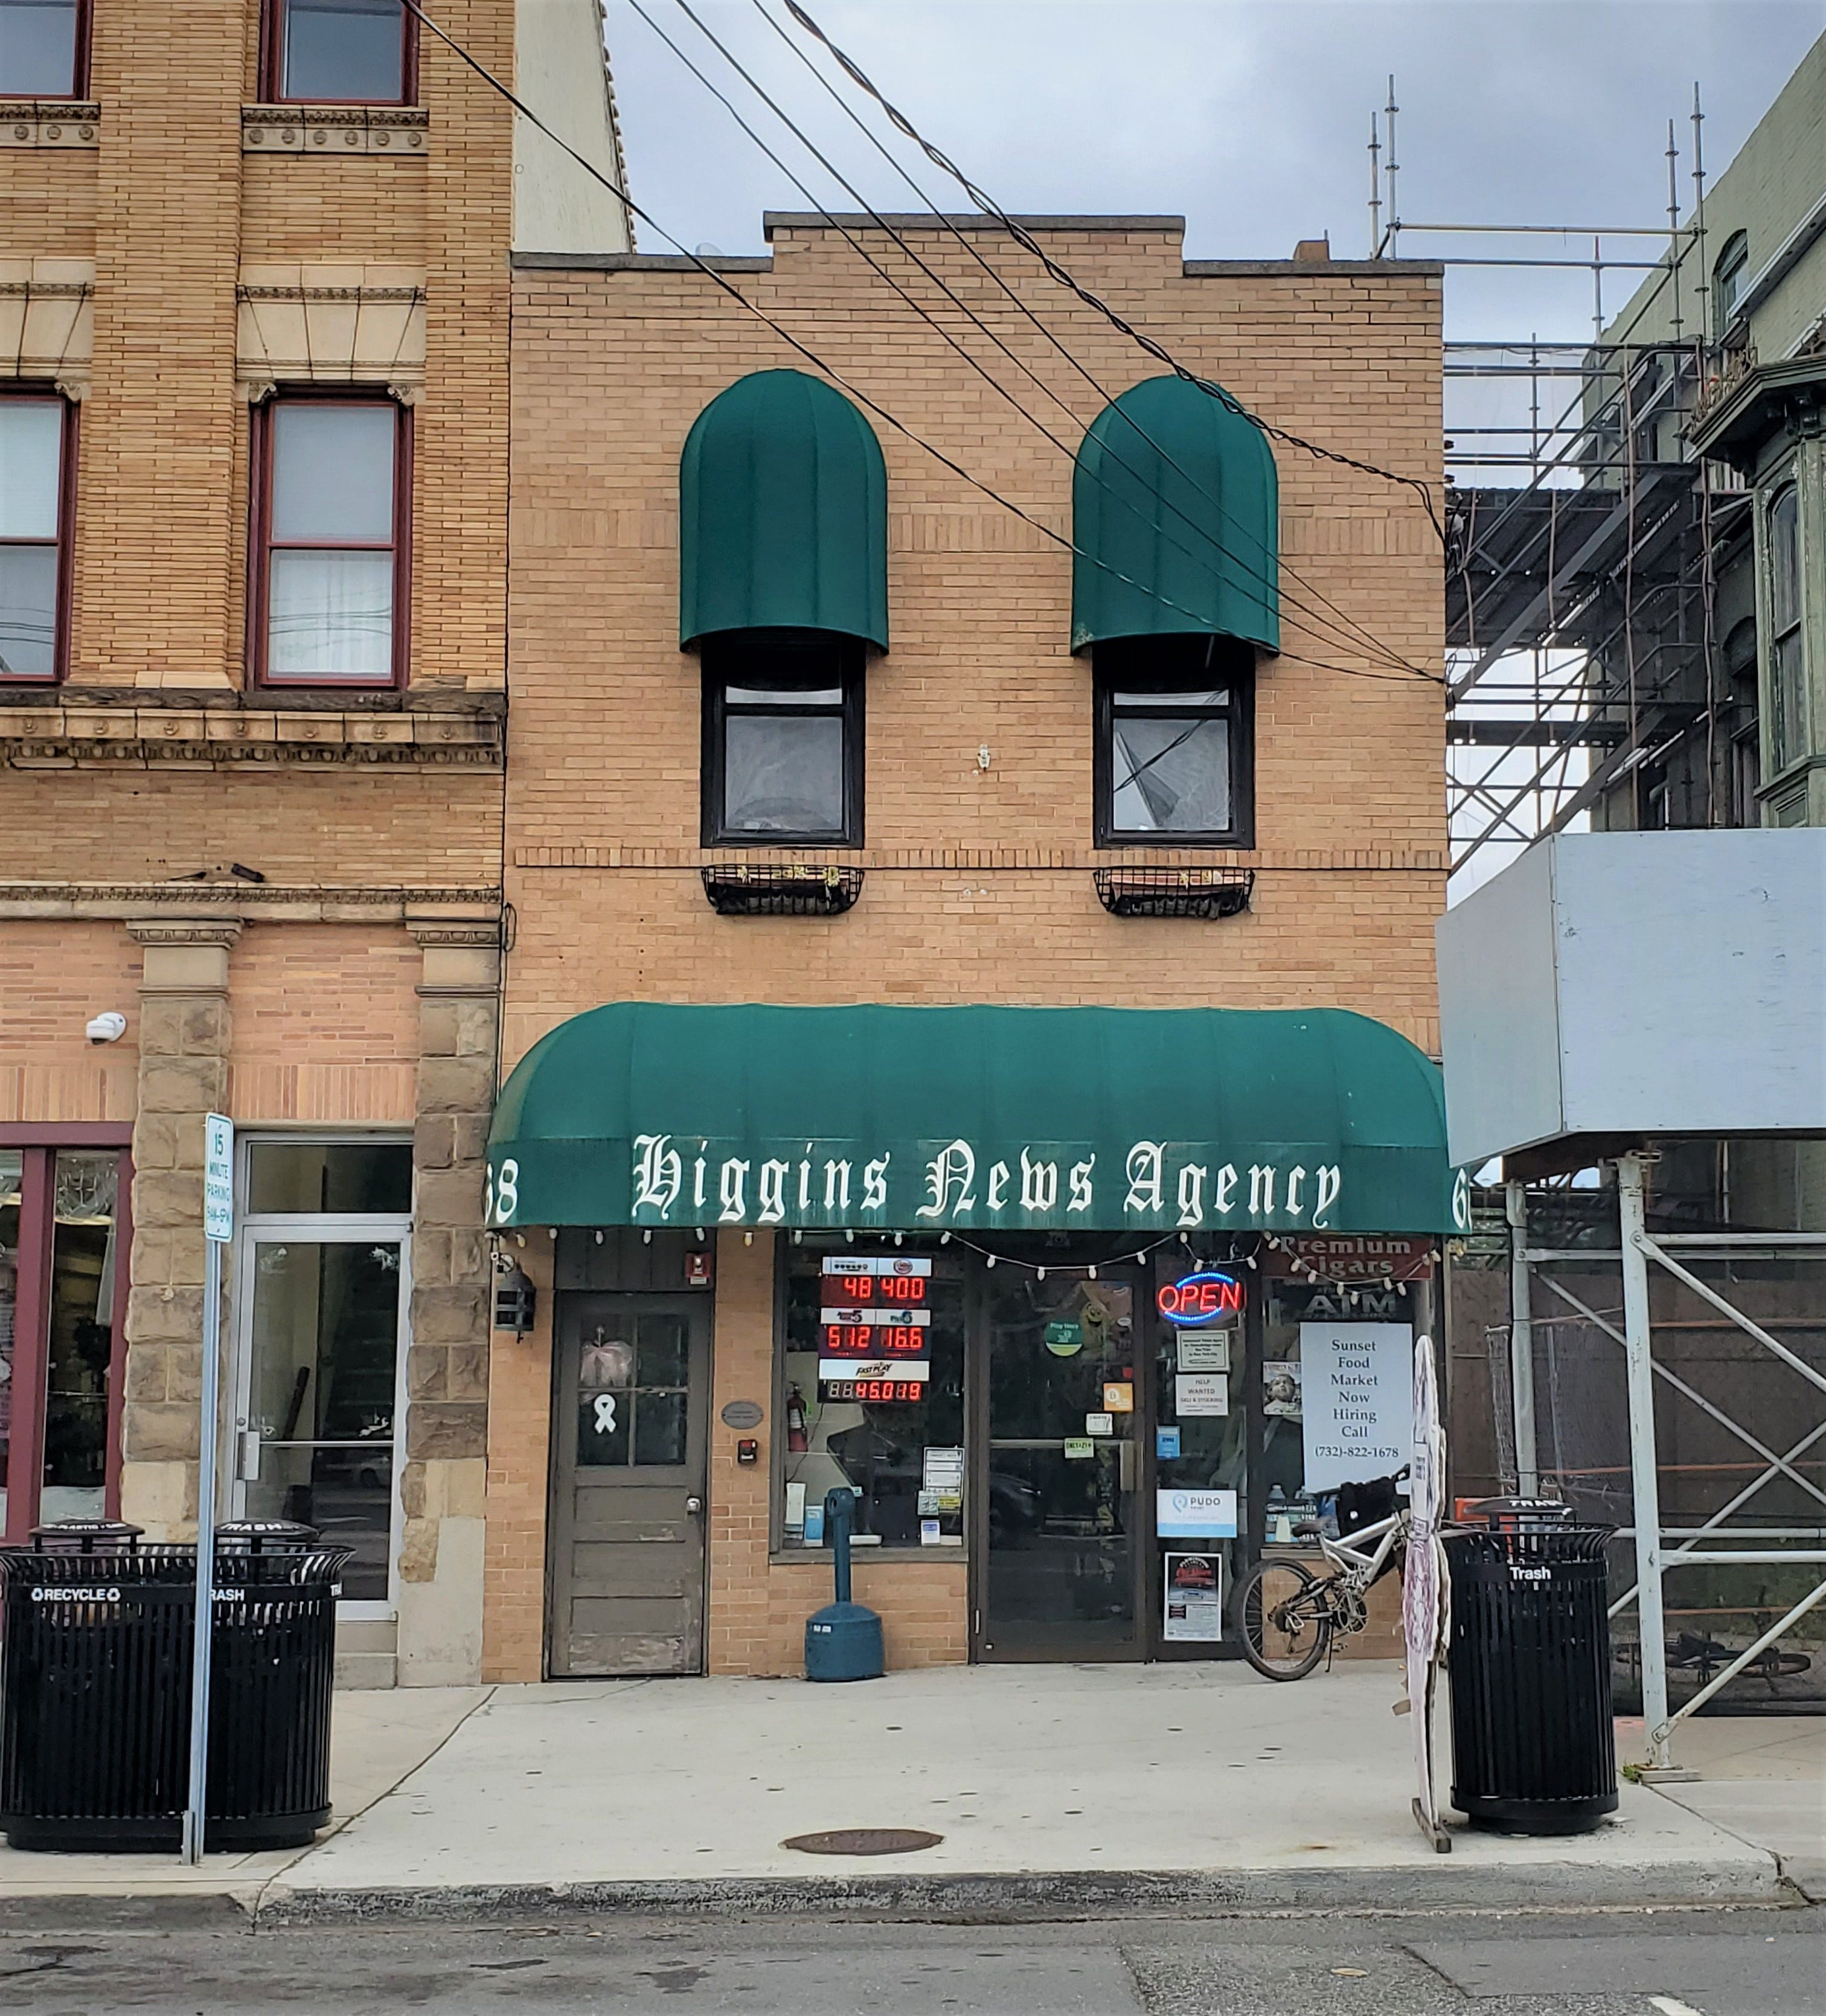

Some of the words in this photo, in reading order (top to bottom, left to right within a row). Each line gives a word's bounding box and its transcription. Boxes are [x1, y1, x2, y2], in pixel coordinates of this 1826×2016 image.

[214, 1133, 223, 1156] 15
[210, 1161, 228, 1179] MINUTE
[632, 1134, 891, 1222] Higgins
[915, 1139, 1096, 1219] News
[1123, 1141, 1341, 1229] Agency
[207, 1183, 229, 1202] PARKING
[1452, 1167, 1472, 1234] 6
[1280, 1237, 1411, 1253] Premium
[1300, 1255, 1394, 1278] Cigars
[844, 1277, 872, 1298] 48
[881, 1277, 924, 1299] 400
[1159, 1282, 1241, 1312] OPEN
[1304, 1294, 1396, 1319] ATM
[1331, 1339, 1377, 1351] Sunset
[1338, 1357, 1370, 1368] Food
[1331, 1374, 1378, 1386] Market
[1339, 1391, 1370, 1403] Now
[1333, 1408, 1377, 1423] Hiring
[1341, 1426, 1368, 1438] Call
[1315, 1447, 1398, 1458] (732)-822-1678
[1510, 1566, 1551, 1580] Trash
[44, 1588, 106, 1601] RECYCLE
[210, 1589, 245, 1601] RASH
